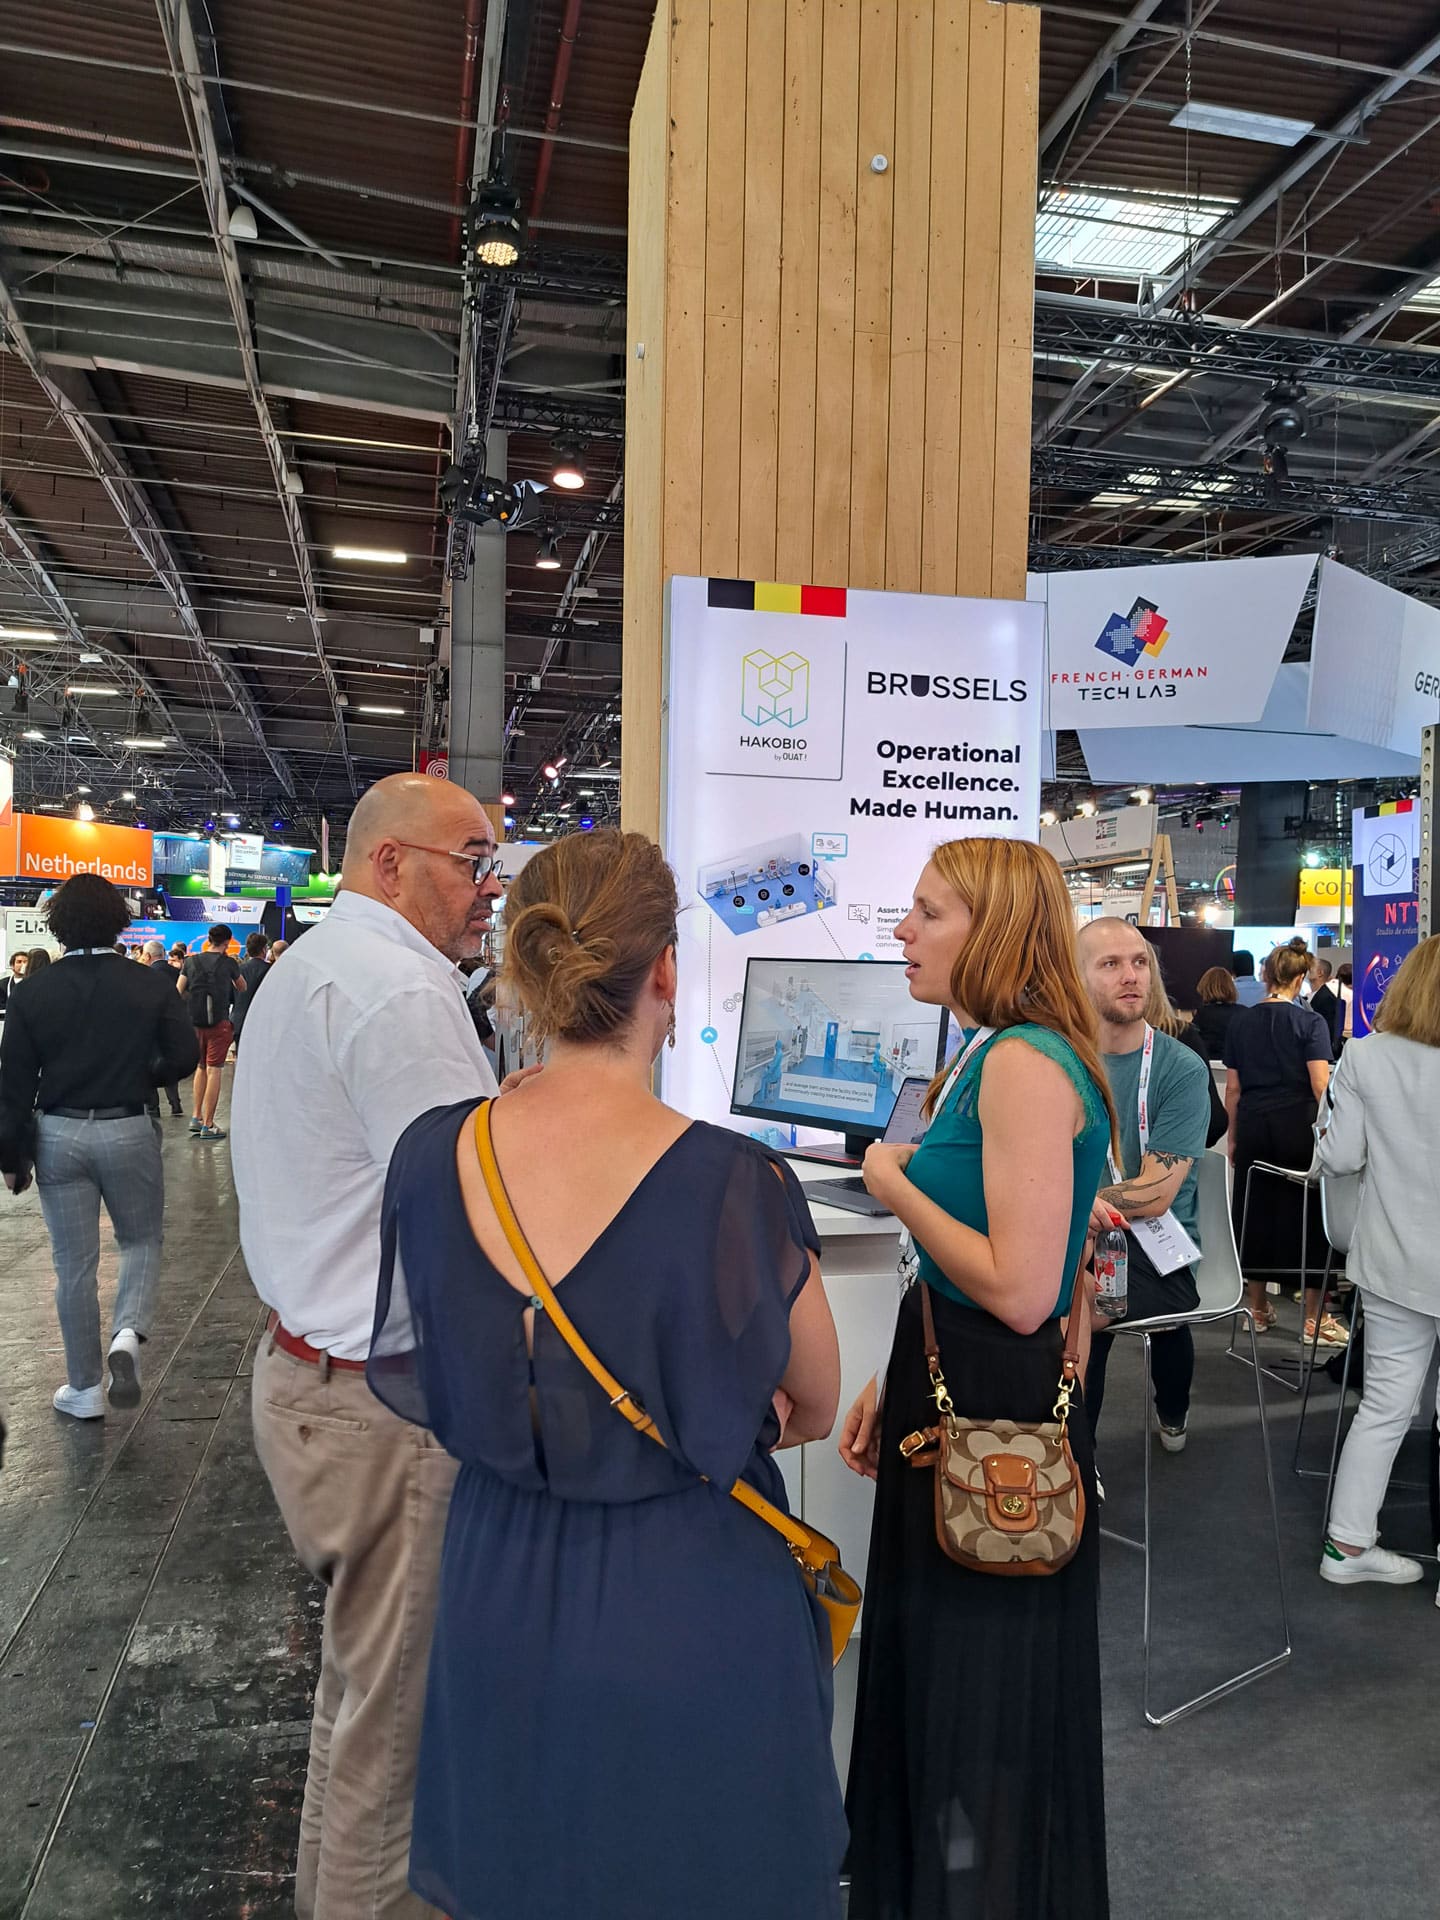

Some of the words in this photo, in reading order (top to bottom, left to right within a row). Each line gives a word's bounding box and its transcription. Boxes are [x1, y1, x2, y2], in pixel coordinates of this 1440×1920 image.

[867, 671, 1028, 703] BRUSSELS
[1078, 686, 1129, 701] TECH
[1137, 684, 1177, 699] LAB
[740, 736, 807, 750] HAKOBIO
[876, 739, 1021, 764] Operational
[774, 754, 782, 762] by
[882, 769, 1020, 792] Excellence.
[850, 797, 917, 818] Made
[924, 799, 1019, 822] Human.
[25, 852, 147, 882] Netherlands
[877, 906, 899, 914] Asset
